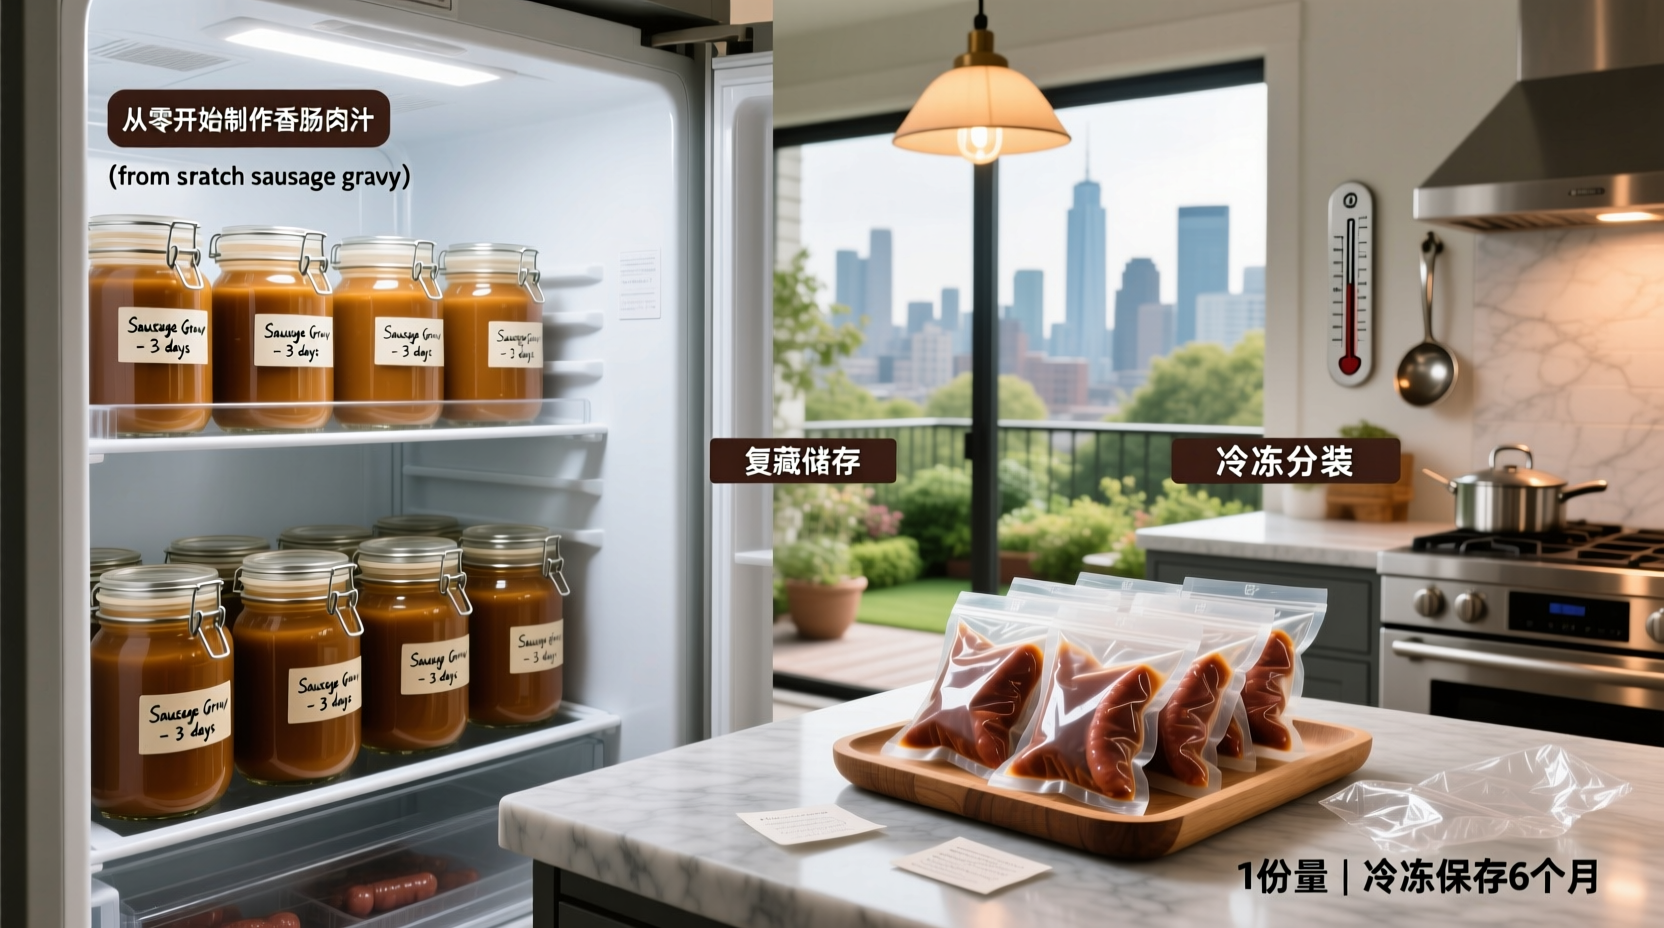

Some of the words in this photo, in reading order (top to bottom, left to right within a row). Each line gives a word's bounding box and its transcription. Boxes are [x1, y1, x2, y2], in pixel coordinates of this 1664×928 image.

[150, 338, 160, 354] 3
[165, 339, 190, 360] days
[286, 344, 294, 357] 3
[402, 345, 410, 358] 3
[533, 651, 539, 663] 3
[429, 672, 436, 684] 3
[320, 697, 328, 711] 3
[175, 726, 184, 742] 3
[190, 721, 215, 742] days
